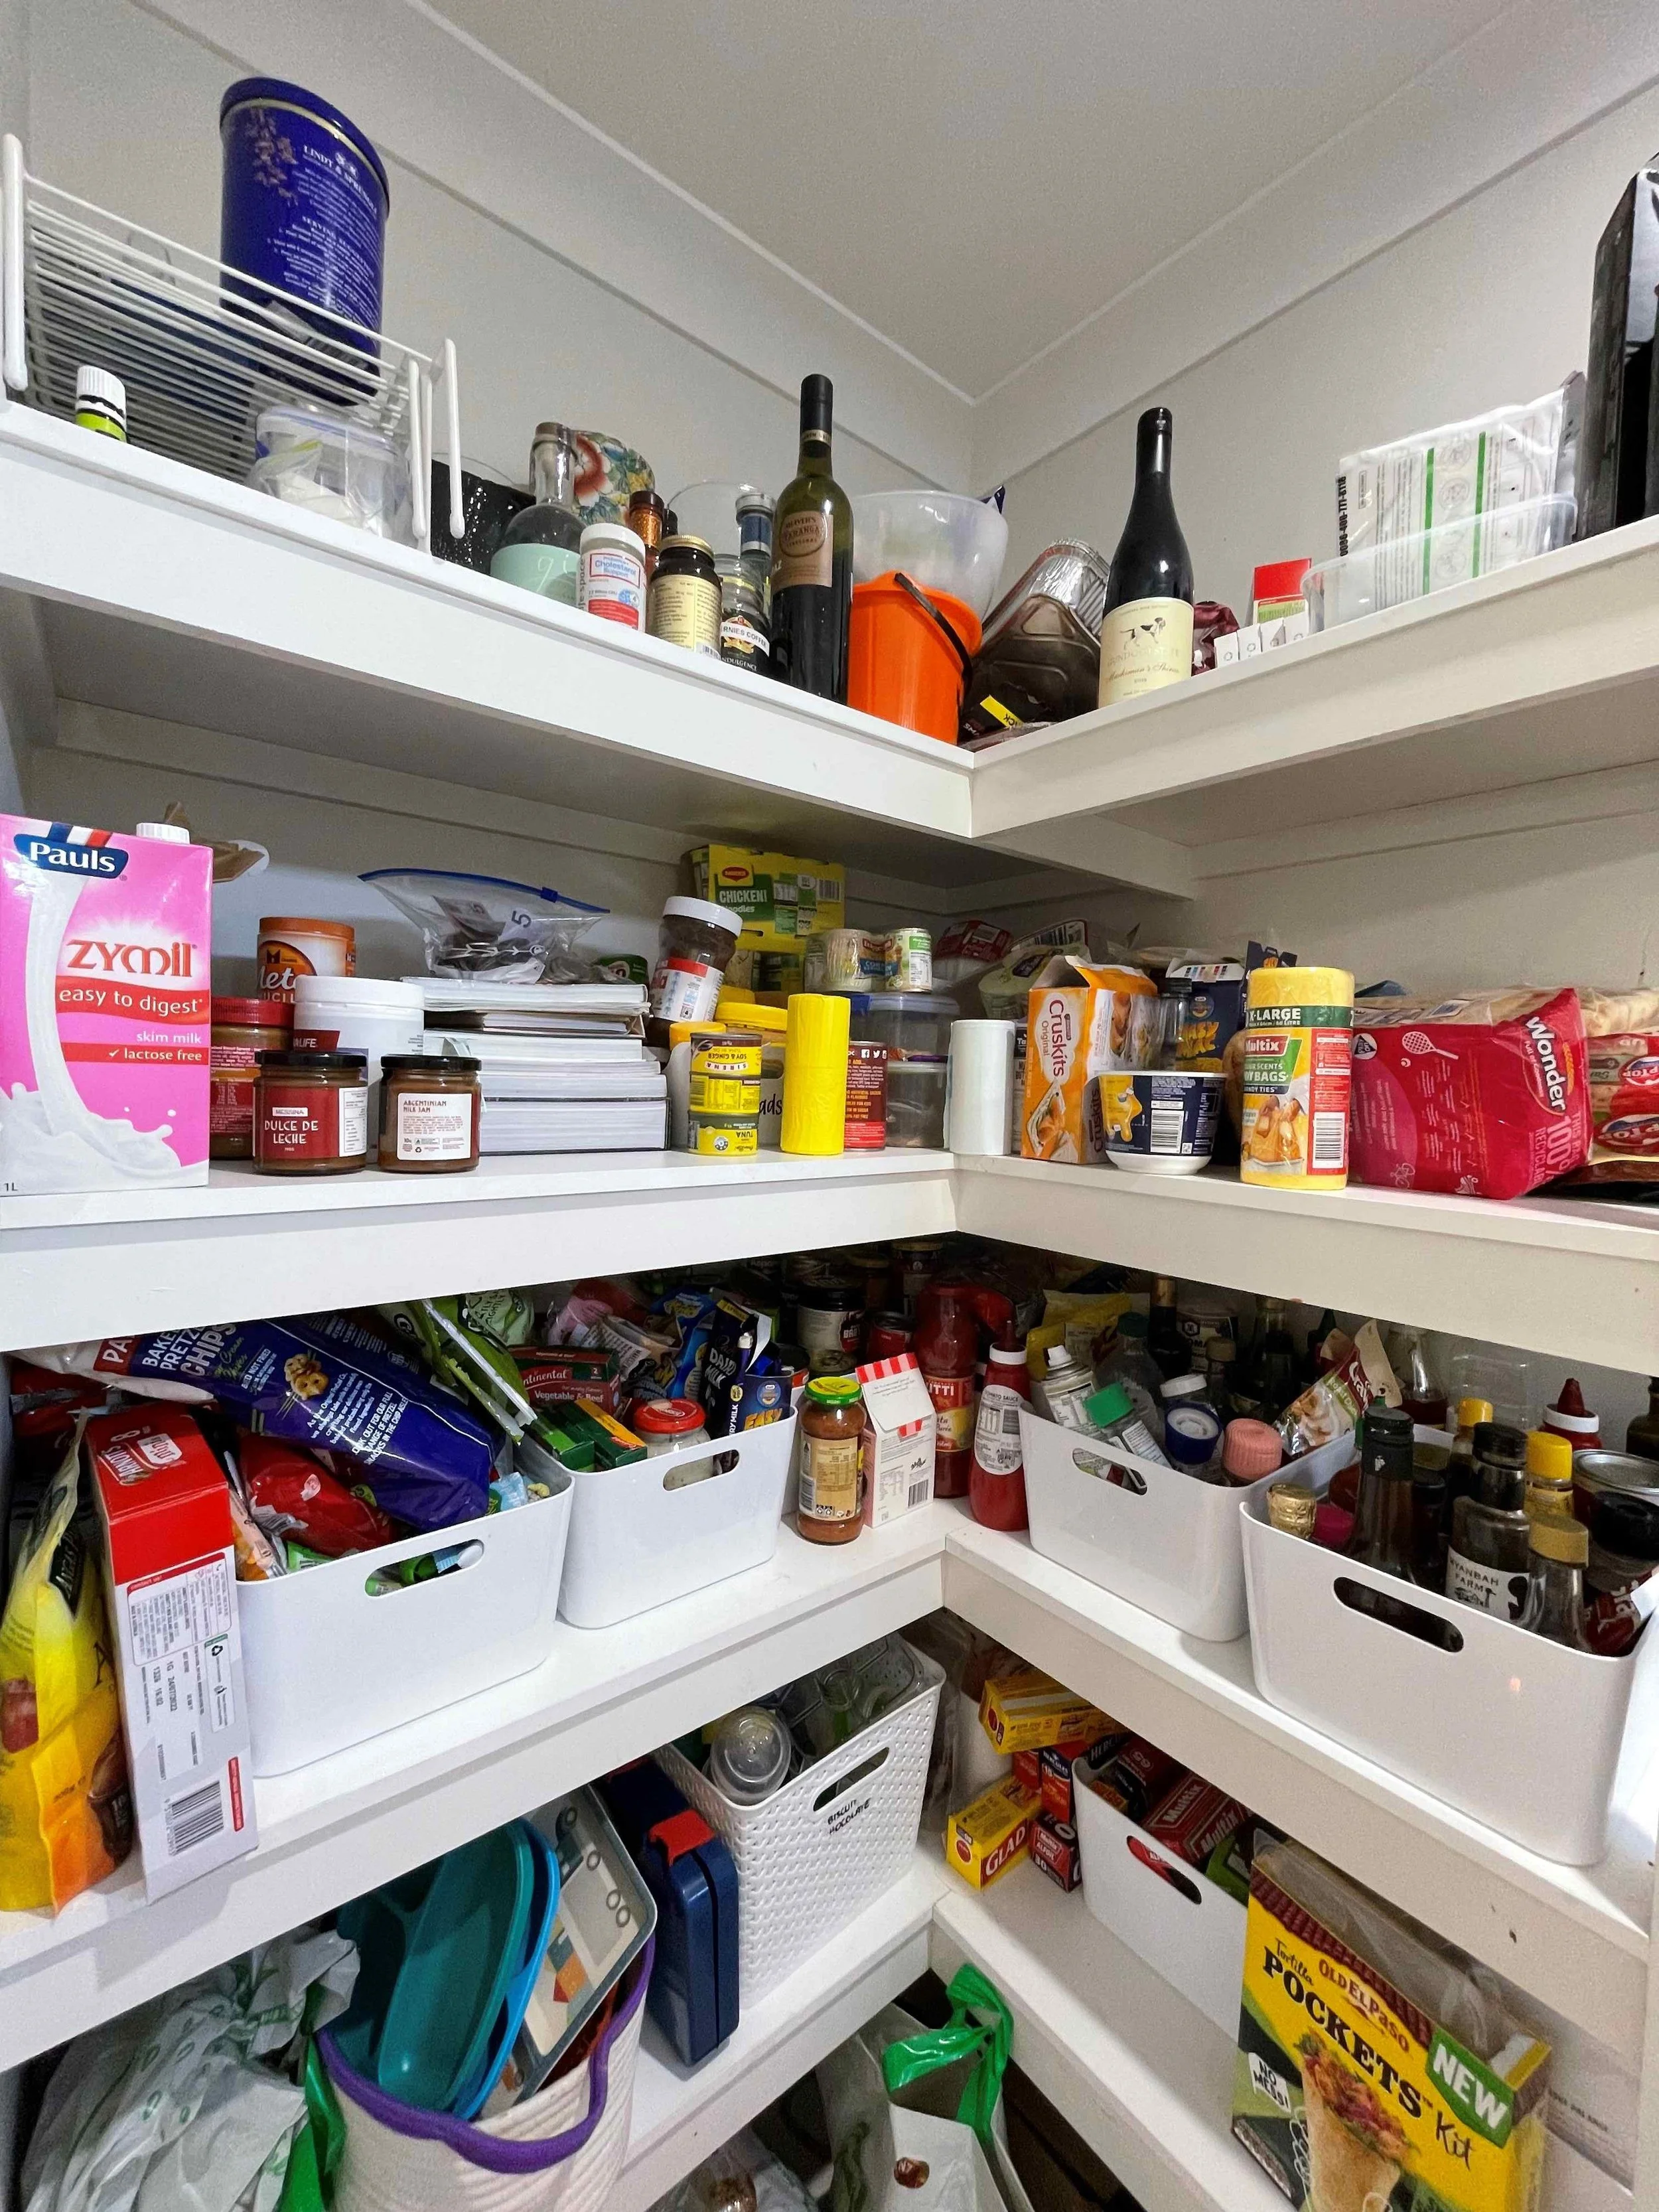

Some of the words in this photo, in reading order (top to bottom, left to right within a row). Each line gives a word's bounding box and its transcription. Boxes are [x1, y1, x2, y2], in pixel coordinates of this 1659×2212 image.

[723, 626, 745, 635] RNIES
[722, 657, 757, 672] NDULGENC
[29, 842, 115, 873] Pauls
[60, 988, 106, 1006] easy
[114, 990, 133, 1007] to
[137, 1032, 169, 1043] skim
[173, 1033, 202, 1044] milk
[1041, 1021, 1050, 1056] Original
[1049, 999, 1068, 1076] Cruskits
[124, 1049, 173, 1061] lactose
[177, 1050, 202, 1061] free
[1526, 1016, 1567, 1110] Wonder
[1255, 1071, 1287, 1082] BAGS
[265, 1120, 297, 1131] DULCE
[303, 1120, 319, 1131] DE
[273, 1134, 307, 1143] LECHE
[1534, 1127, 1547, 1184] RECYCLAB
[3, 1182, 17, 1192] 1L
[142, 1329, 179, 1366] BAKE
[161, 1324, 201, 1371] PRETZ
[523, 1369, 568, 1386] ntinental
[930, 1383, 954, 1396] TTI
[534, 1390, 575, 1401] Vegetable
[363, 1423, 375, 1438] OUT
[828, 1799, 857, 1824] BISCUIT
[1163, 1784, 1204, 1823] Multix
[1200, 1810, 1239, 1854] Multix
[985, 1826, 1025, 1876] GLAD
[1275, 1937, 1314, 1986] Tortilla
[1319, 1958, 1346, 1988] OLD
[1263, 1945, 1423, 2118] POCKETS
[1259, 2061, 1276, 2085] NO
[1433, 2043, 1508, 2129] NEW
[1435, 2110, 1475, 2171] Kit
